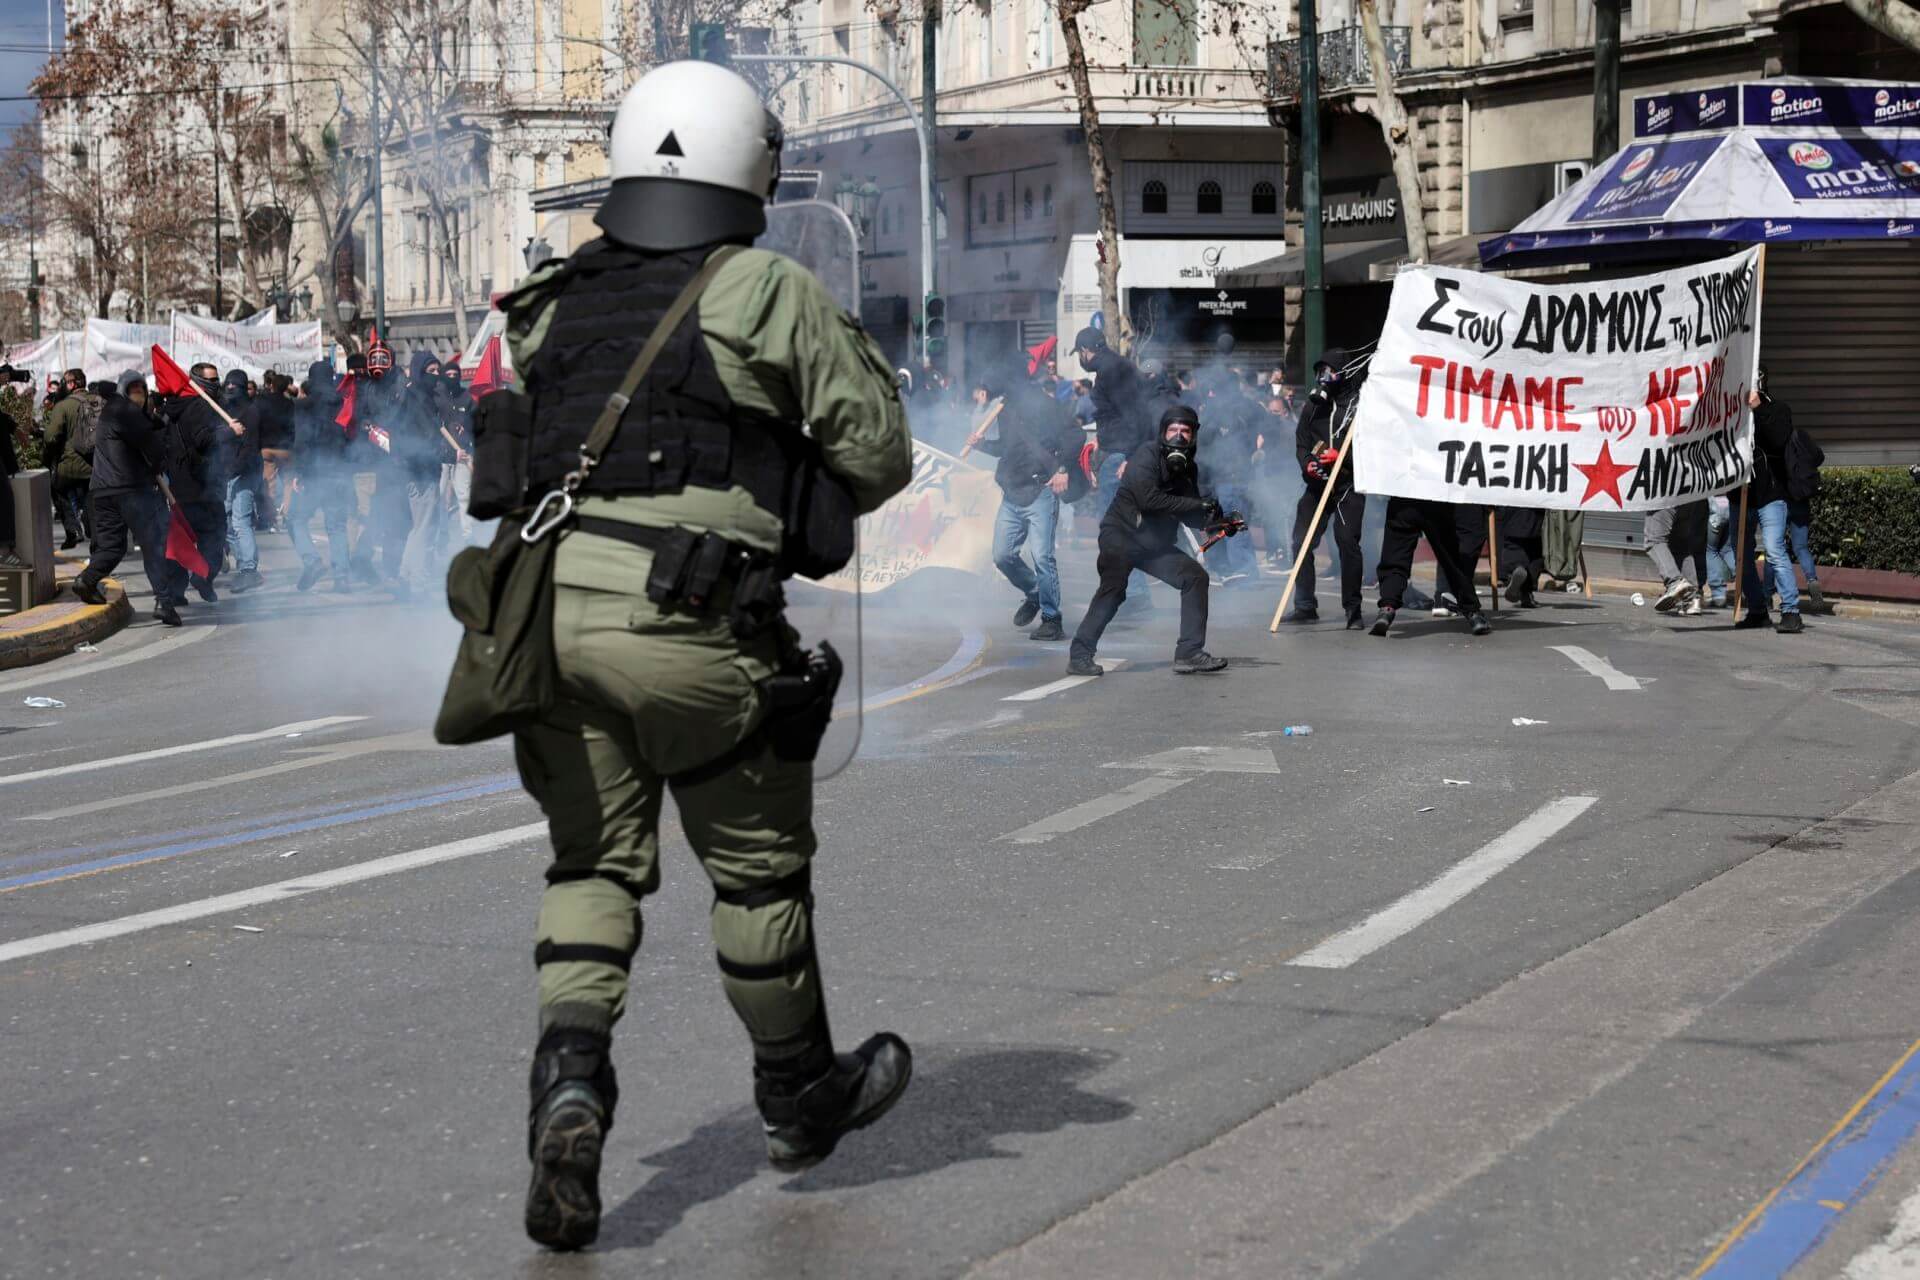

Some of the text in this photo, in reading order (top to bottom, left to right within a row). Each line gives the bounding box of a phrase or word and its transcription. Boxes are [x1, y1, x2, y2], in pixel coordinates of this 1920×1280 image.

[1771, 97, 1822, 117] motion
[1805, 160, 1920, 190] motio
[1180, 267, 1203, 279] stella
[1512, 283, 1666, 354] ΔΡΟΜΟΥΣ
[1409, 355, 1584, 433] ΤΙΜΑΜΕ
[1438, 440, 1569, 494] ΤΑΞΙΚΗ
